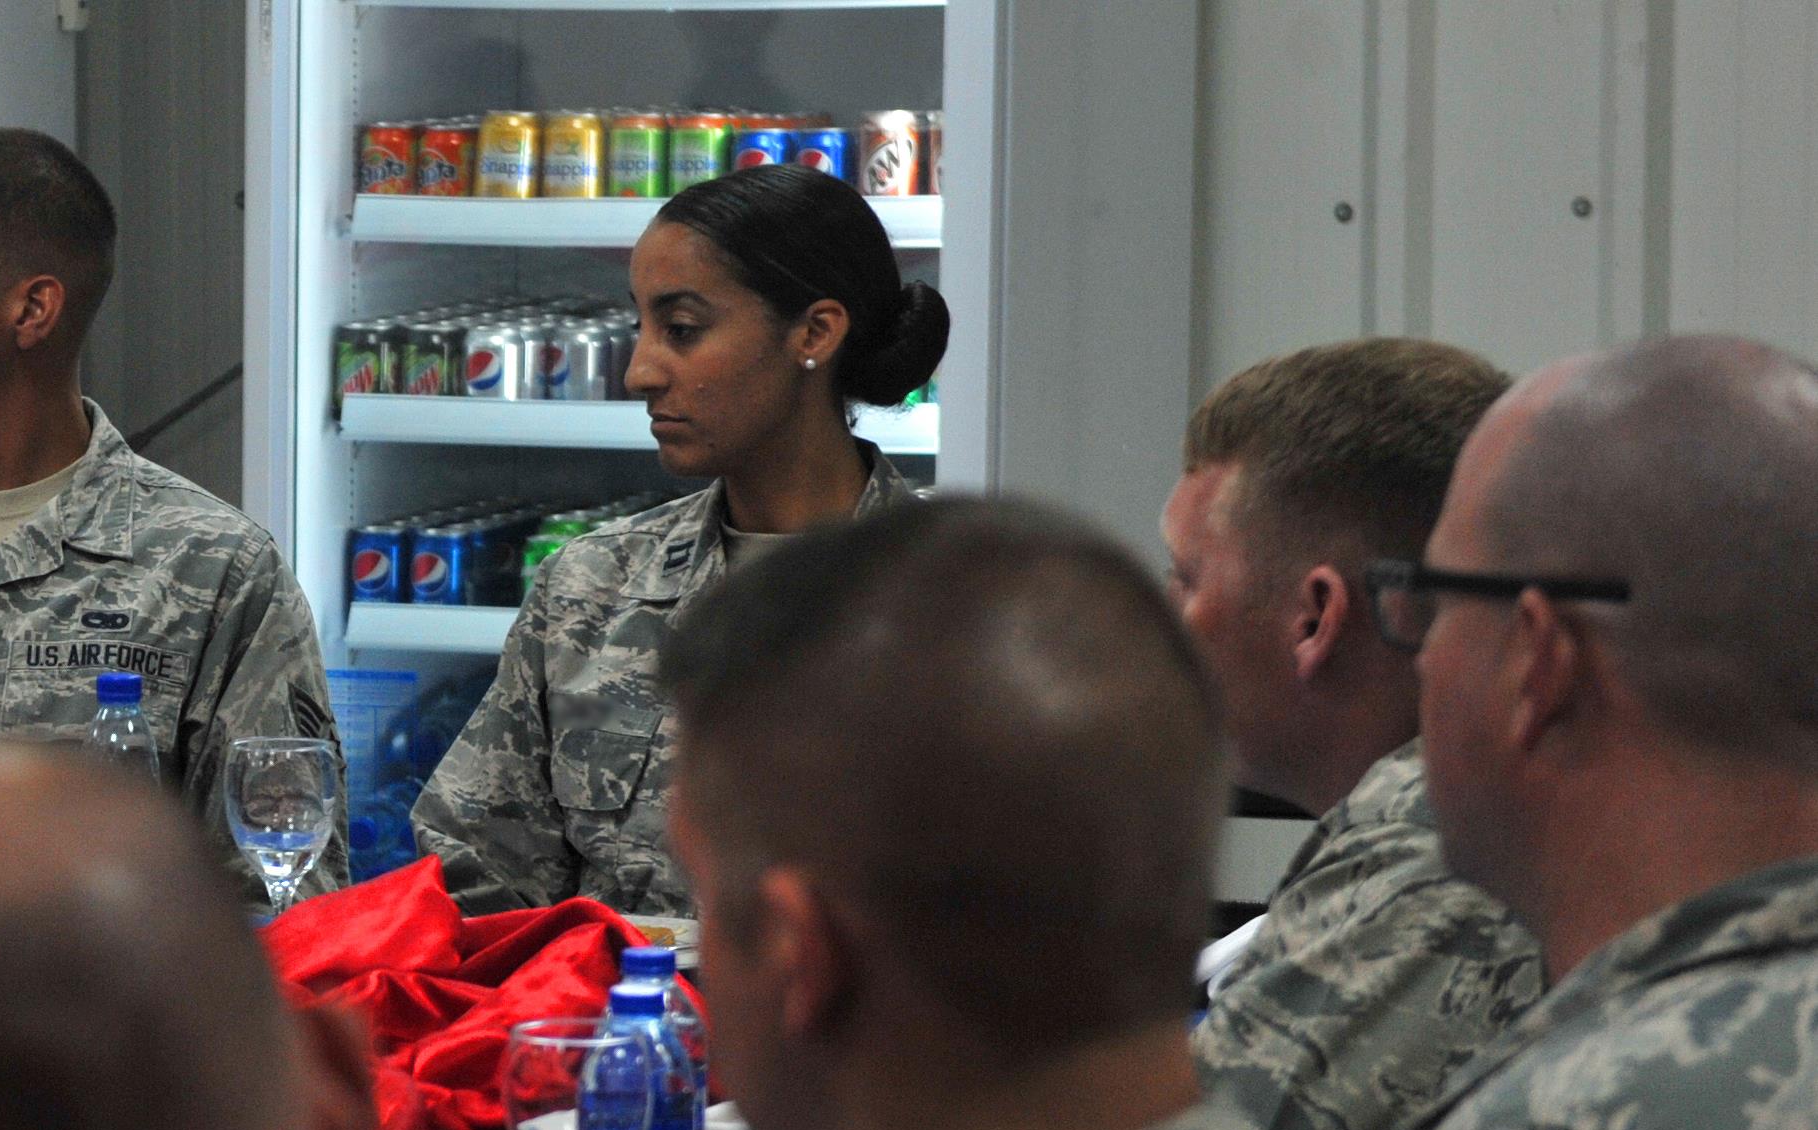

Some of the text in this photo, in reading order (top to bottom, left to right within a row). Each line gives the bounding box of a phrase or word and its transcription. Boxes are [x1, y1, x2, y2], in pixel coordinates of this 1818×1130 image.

[26, 643, 173, 678] U.S. AIR FORCE
